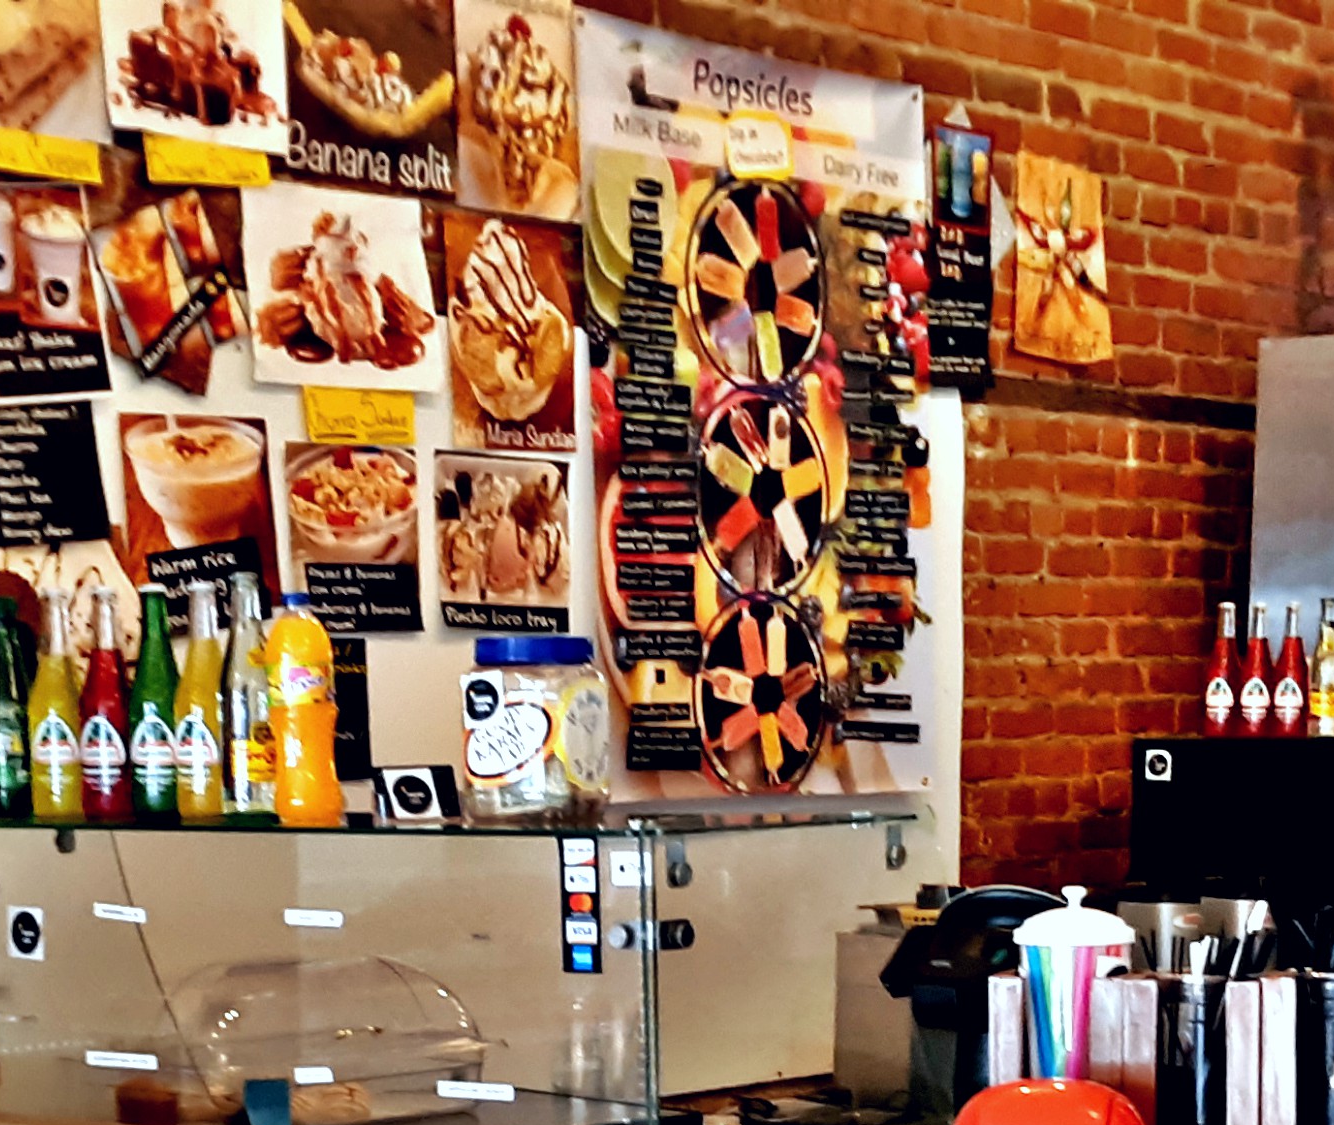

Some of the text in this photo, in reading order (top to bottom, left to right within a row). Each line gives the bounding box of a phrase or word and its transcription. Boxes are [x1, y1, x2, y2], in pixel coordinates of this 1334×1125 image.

[693, 58, 814, 116] Popsicles
[614, 112, 703, 149] Milk Base
[285, 119, 392, 186] Banana
[398, 142, 454, 193] split
[822, 154, 899, 188] Dairy Free
